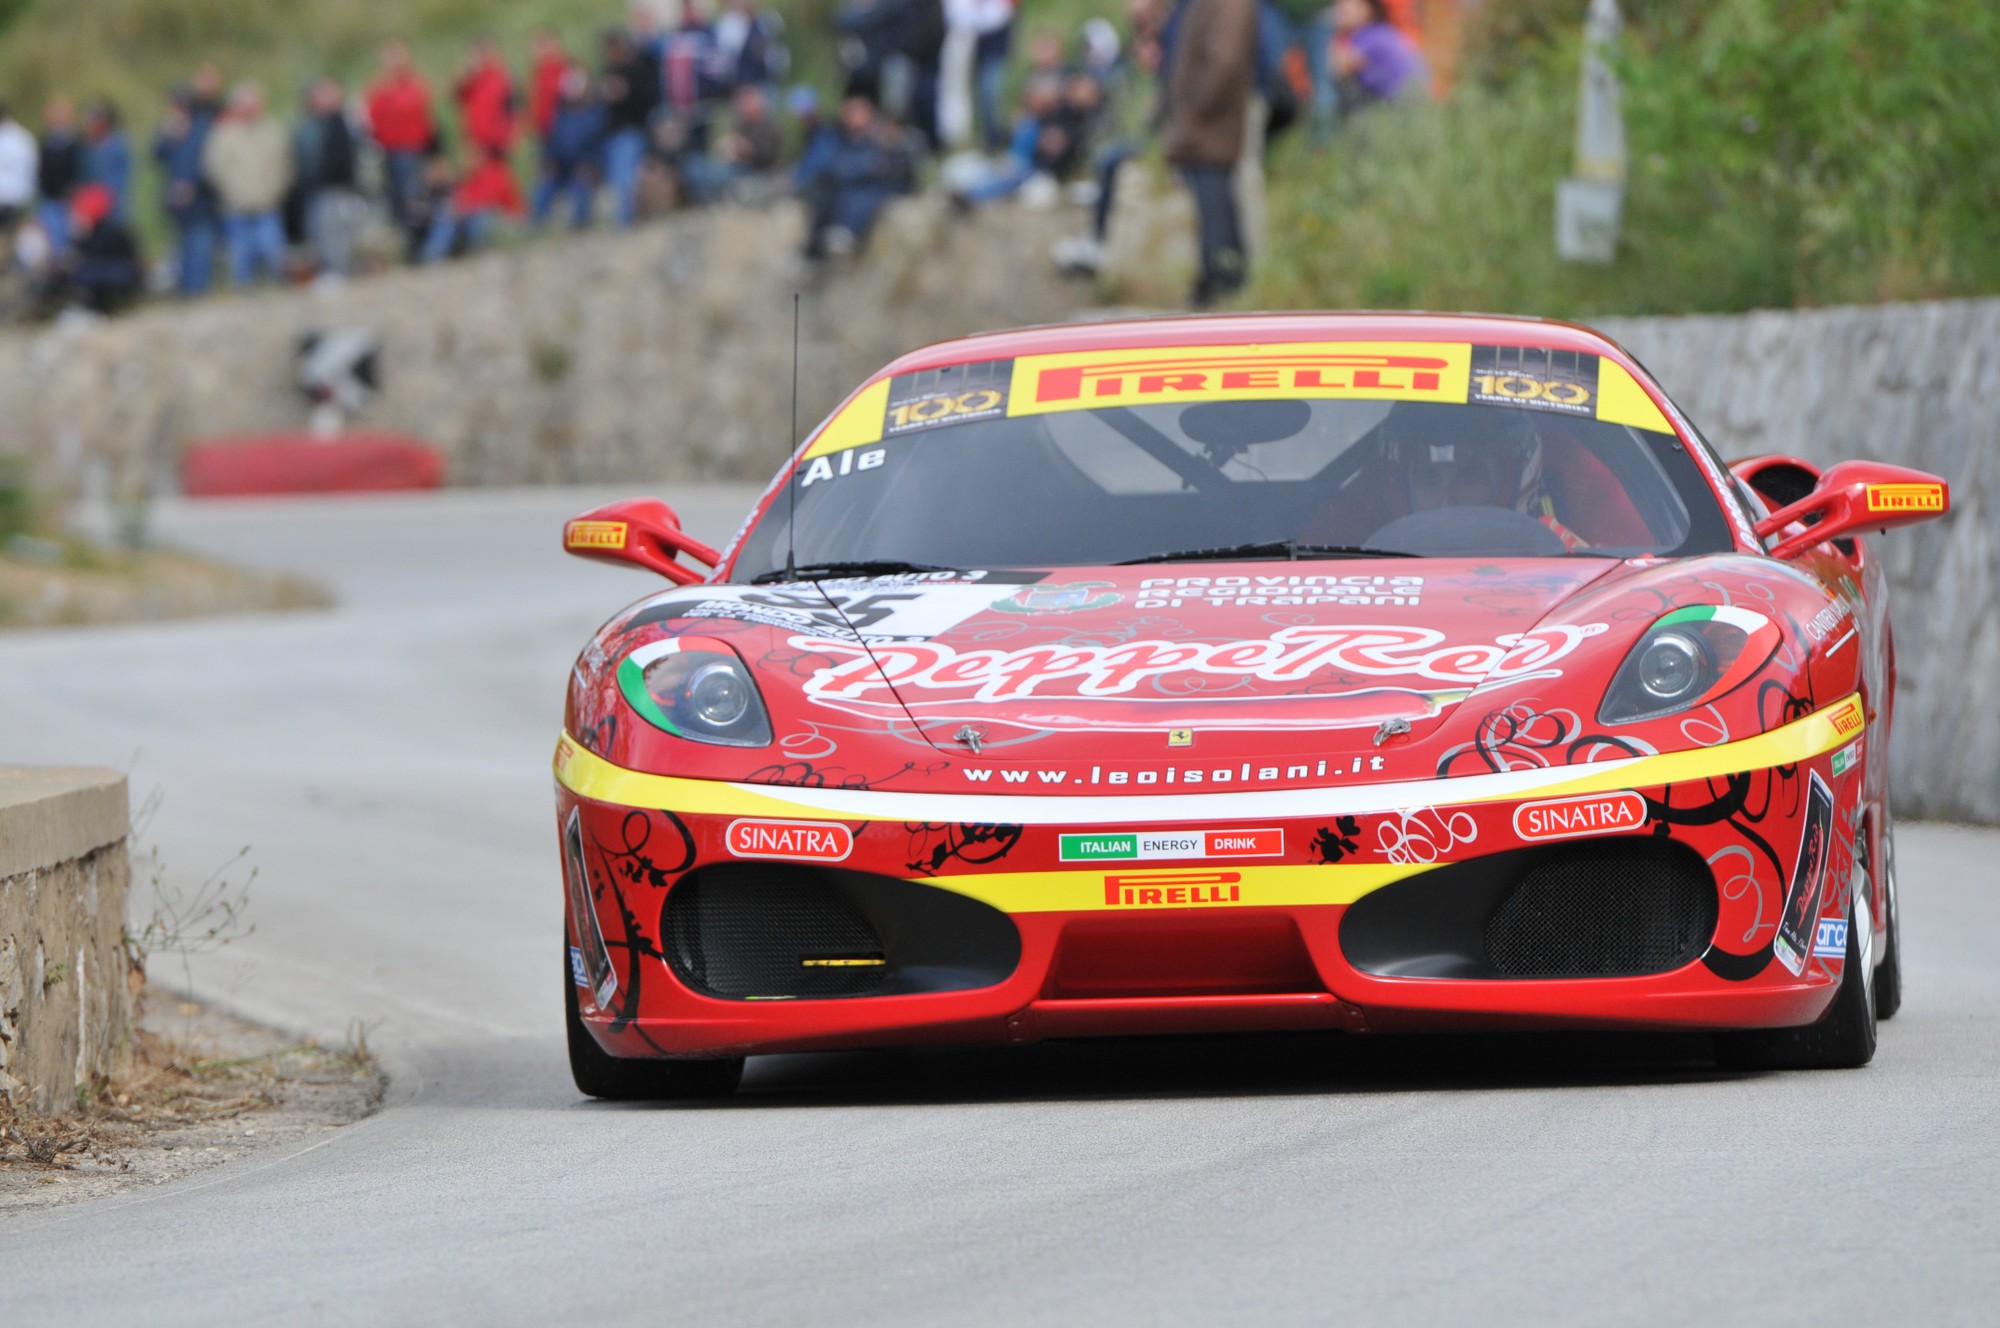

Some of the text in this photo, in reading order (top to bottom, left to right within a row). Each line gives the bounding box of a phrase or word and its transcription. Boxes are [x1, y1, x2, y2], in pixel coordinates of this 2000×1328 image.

[1035, 354, 1449, 403] PIRELLI
[1474, 375, 1590, 406] 100
[889, 390, 1002, 426] 100
[1871, 488, 1940, 507] PIRELLI
[1137, 586, 1423, 598] REGIONALE
[1140, 575, 1425, 588] PROVINCIA
[1134, 595, 1421, 609] DI TRAPANI
[1827, 703, 1863, 735] PIRELLI
[963, 756, 1385, 785] www.leoisolani.it
[1529, 800, 1633, 833] SINATRA
[739, 826, 839, 853] SINATRA
[1080, 837, 1256, 854] ITALIAN ENERGY DRINK
[1104, 872, 1241, 906] PIRELLI
